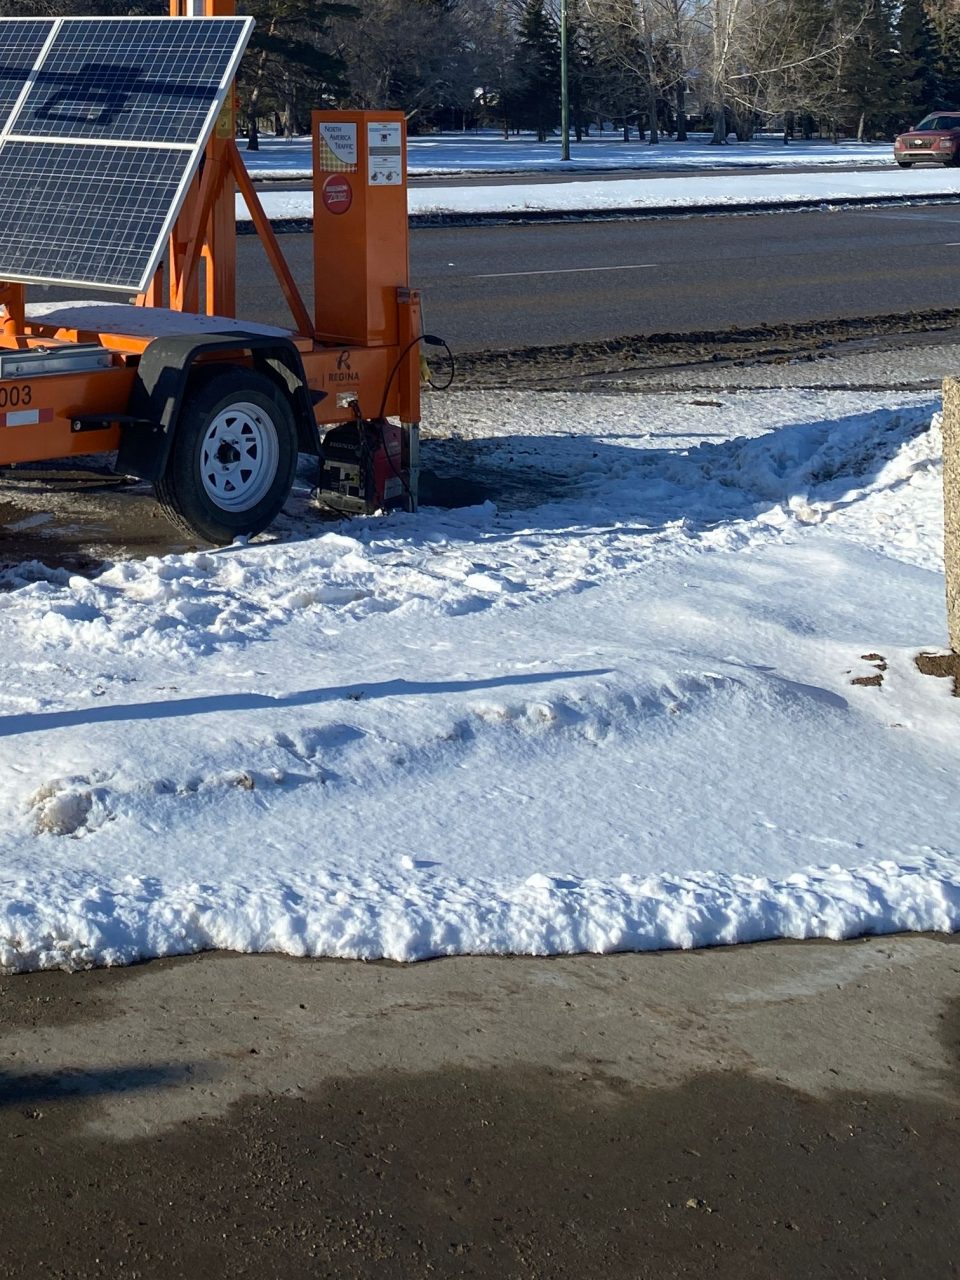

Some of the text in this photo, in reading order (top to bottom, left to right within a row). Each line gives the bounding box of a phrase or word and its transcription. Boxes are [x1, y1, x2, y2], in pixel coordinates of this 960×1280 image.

[329, 133, 352, 141] AMERICA
[334, 142, 354, 150] TRAFFIC
[328, 371, 360, 382] REGINA
